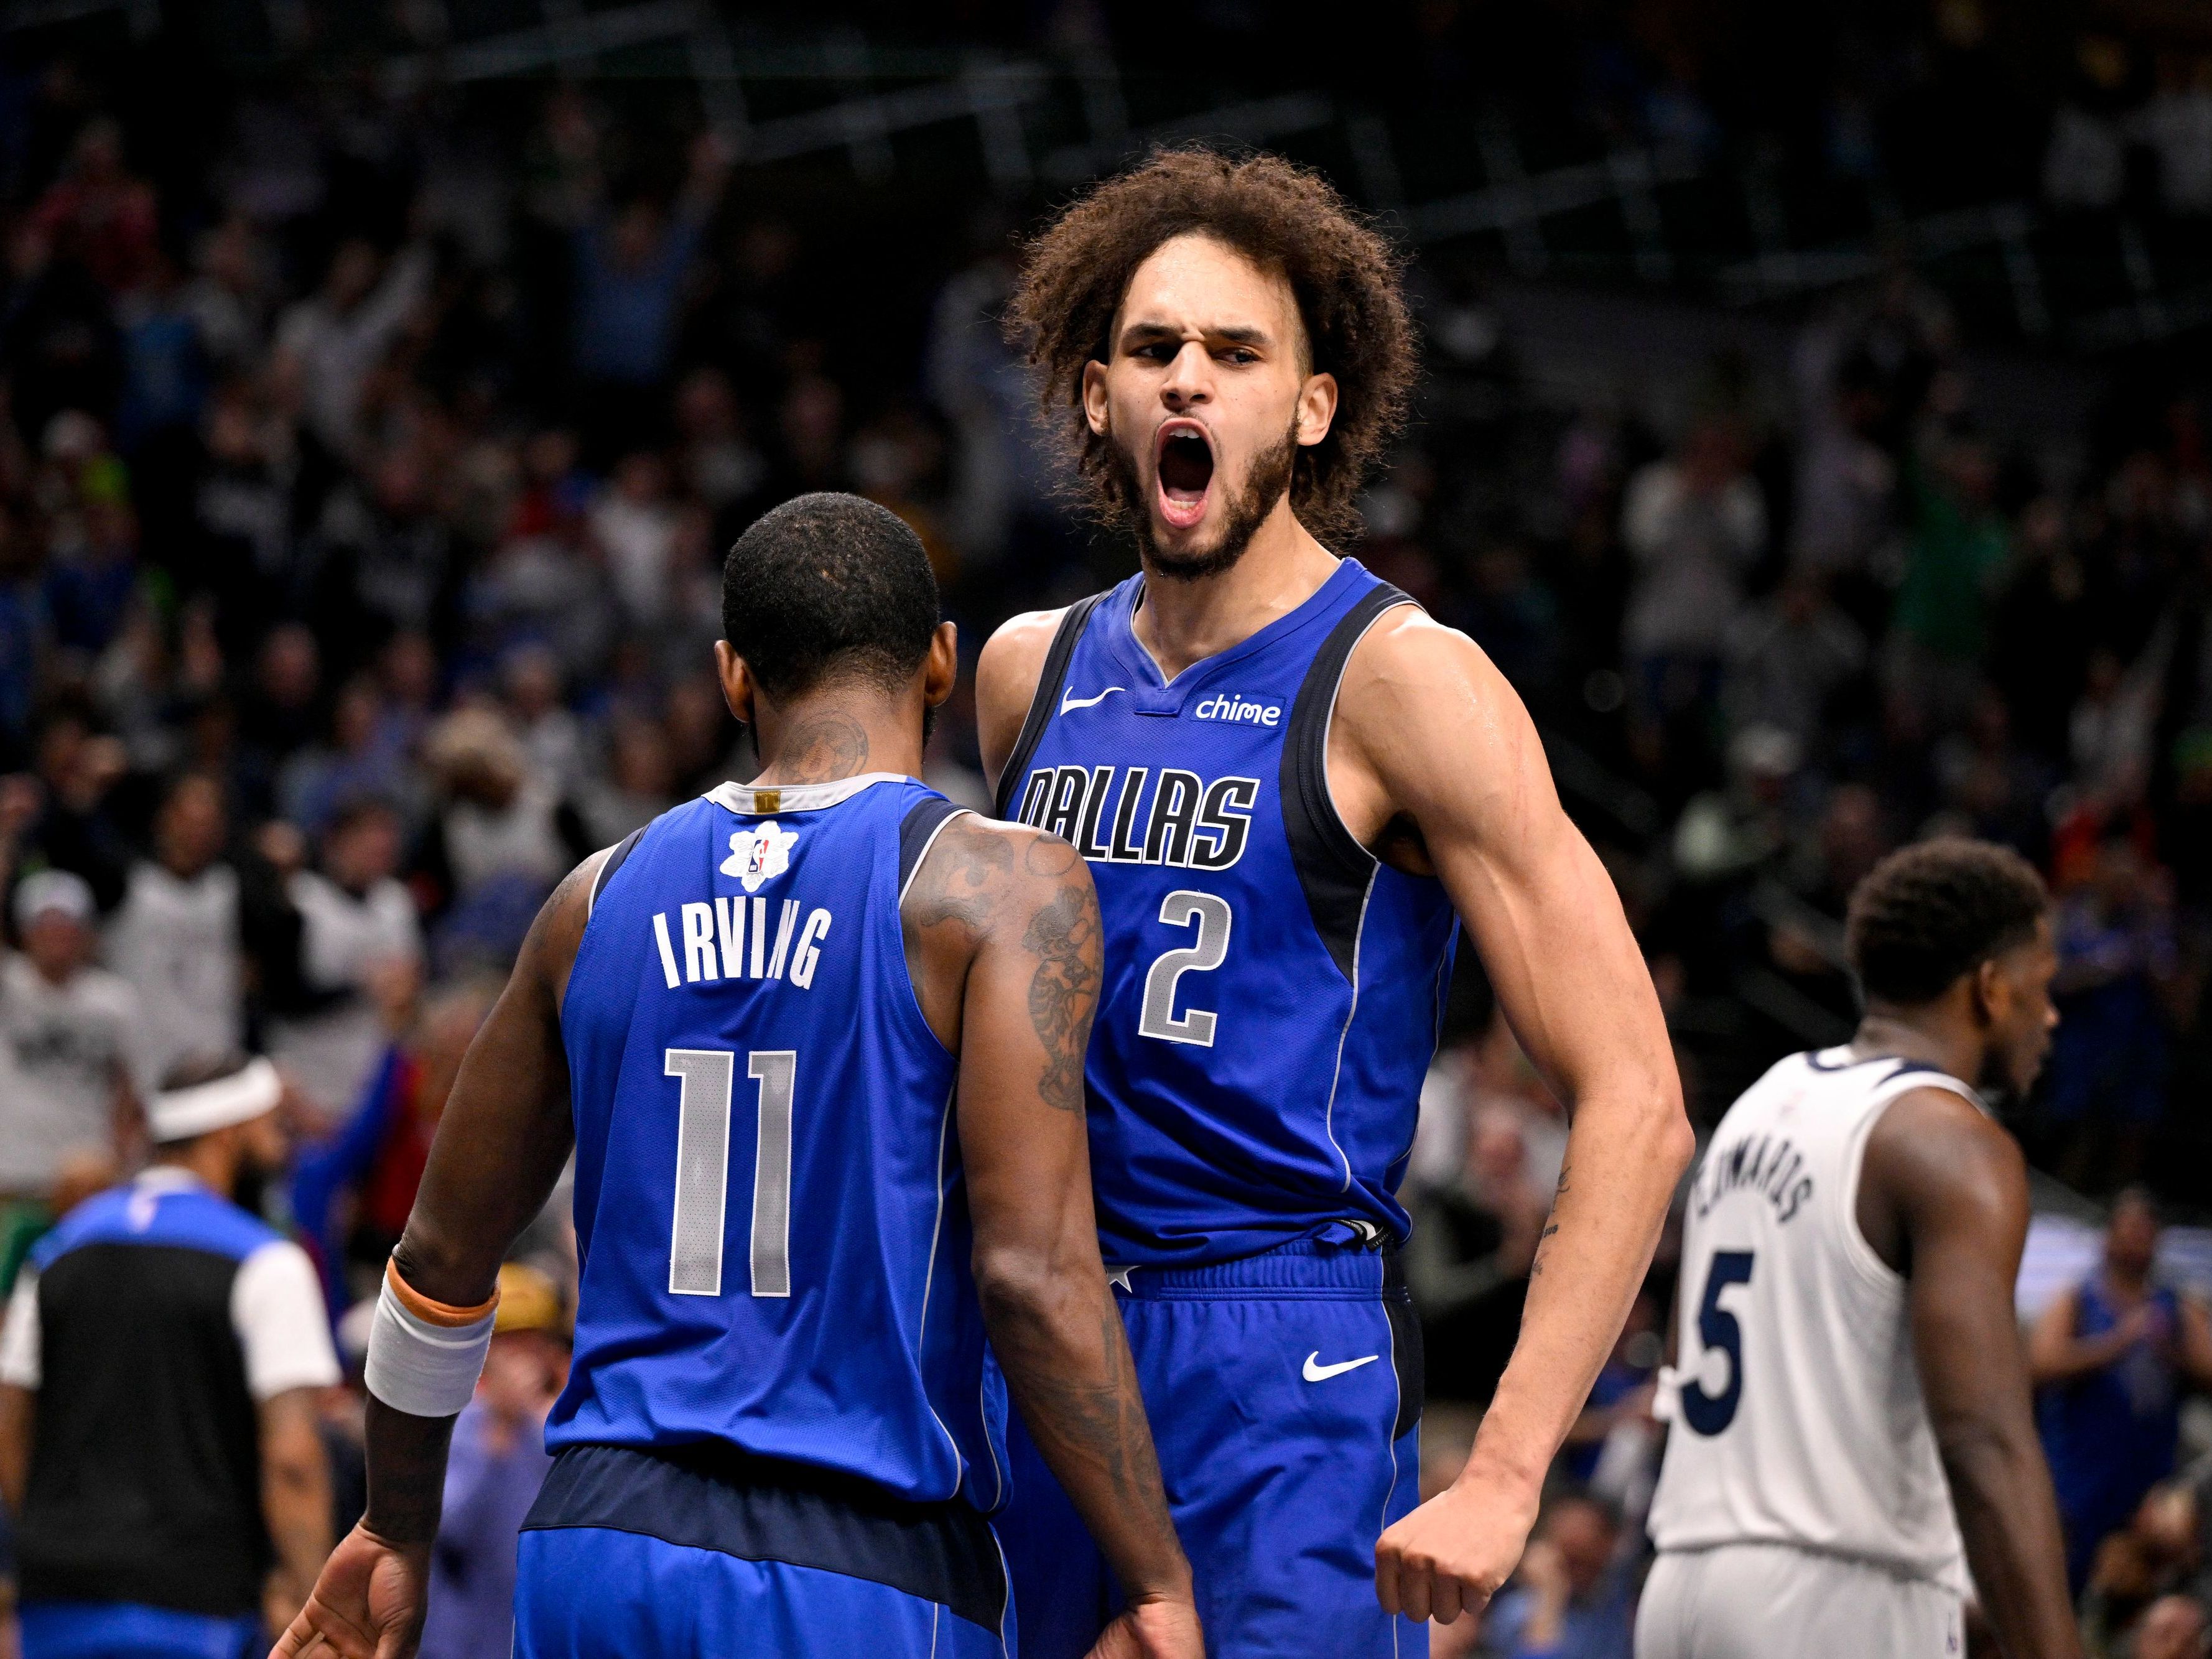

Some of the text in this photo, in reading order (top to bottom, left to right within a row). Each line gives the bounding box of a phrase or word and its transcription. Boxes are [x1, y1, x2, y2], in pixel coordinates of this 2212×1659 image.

[1196, 694, 1281, 726] chime
[1018, 765, 1260, 871] DALLAS
[653, 896, 832, 990] IRVING
[1138, 890, 1232, 1048] 2
[664, 1048, 796, 1298] 11
[1681, 1252, 1754, 1436] 5
